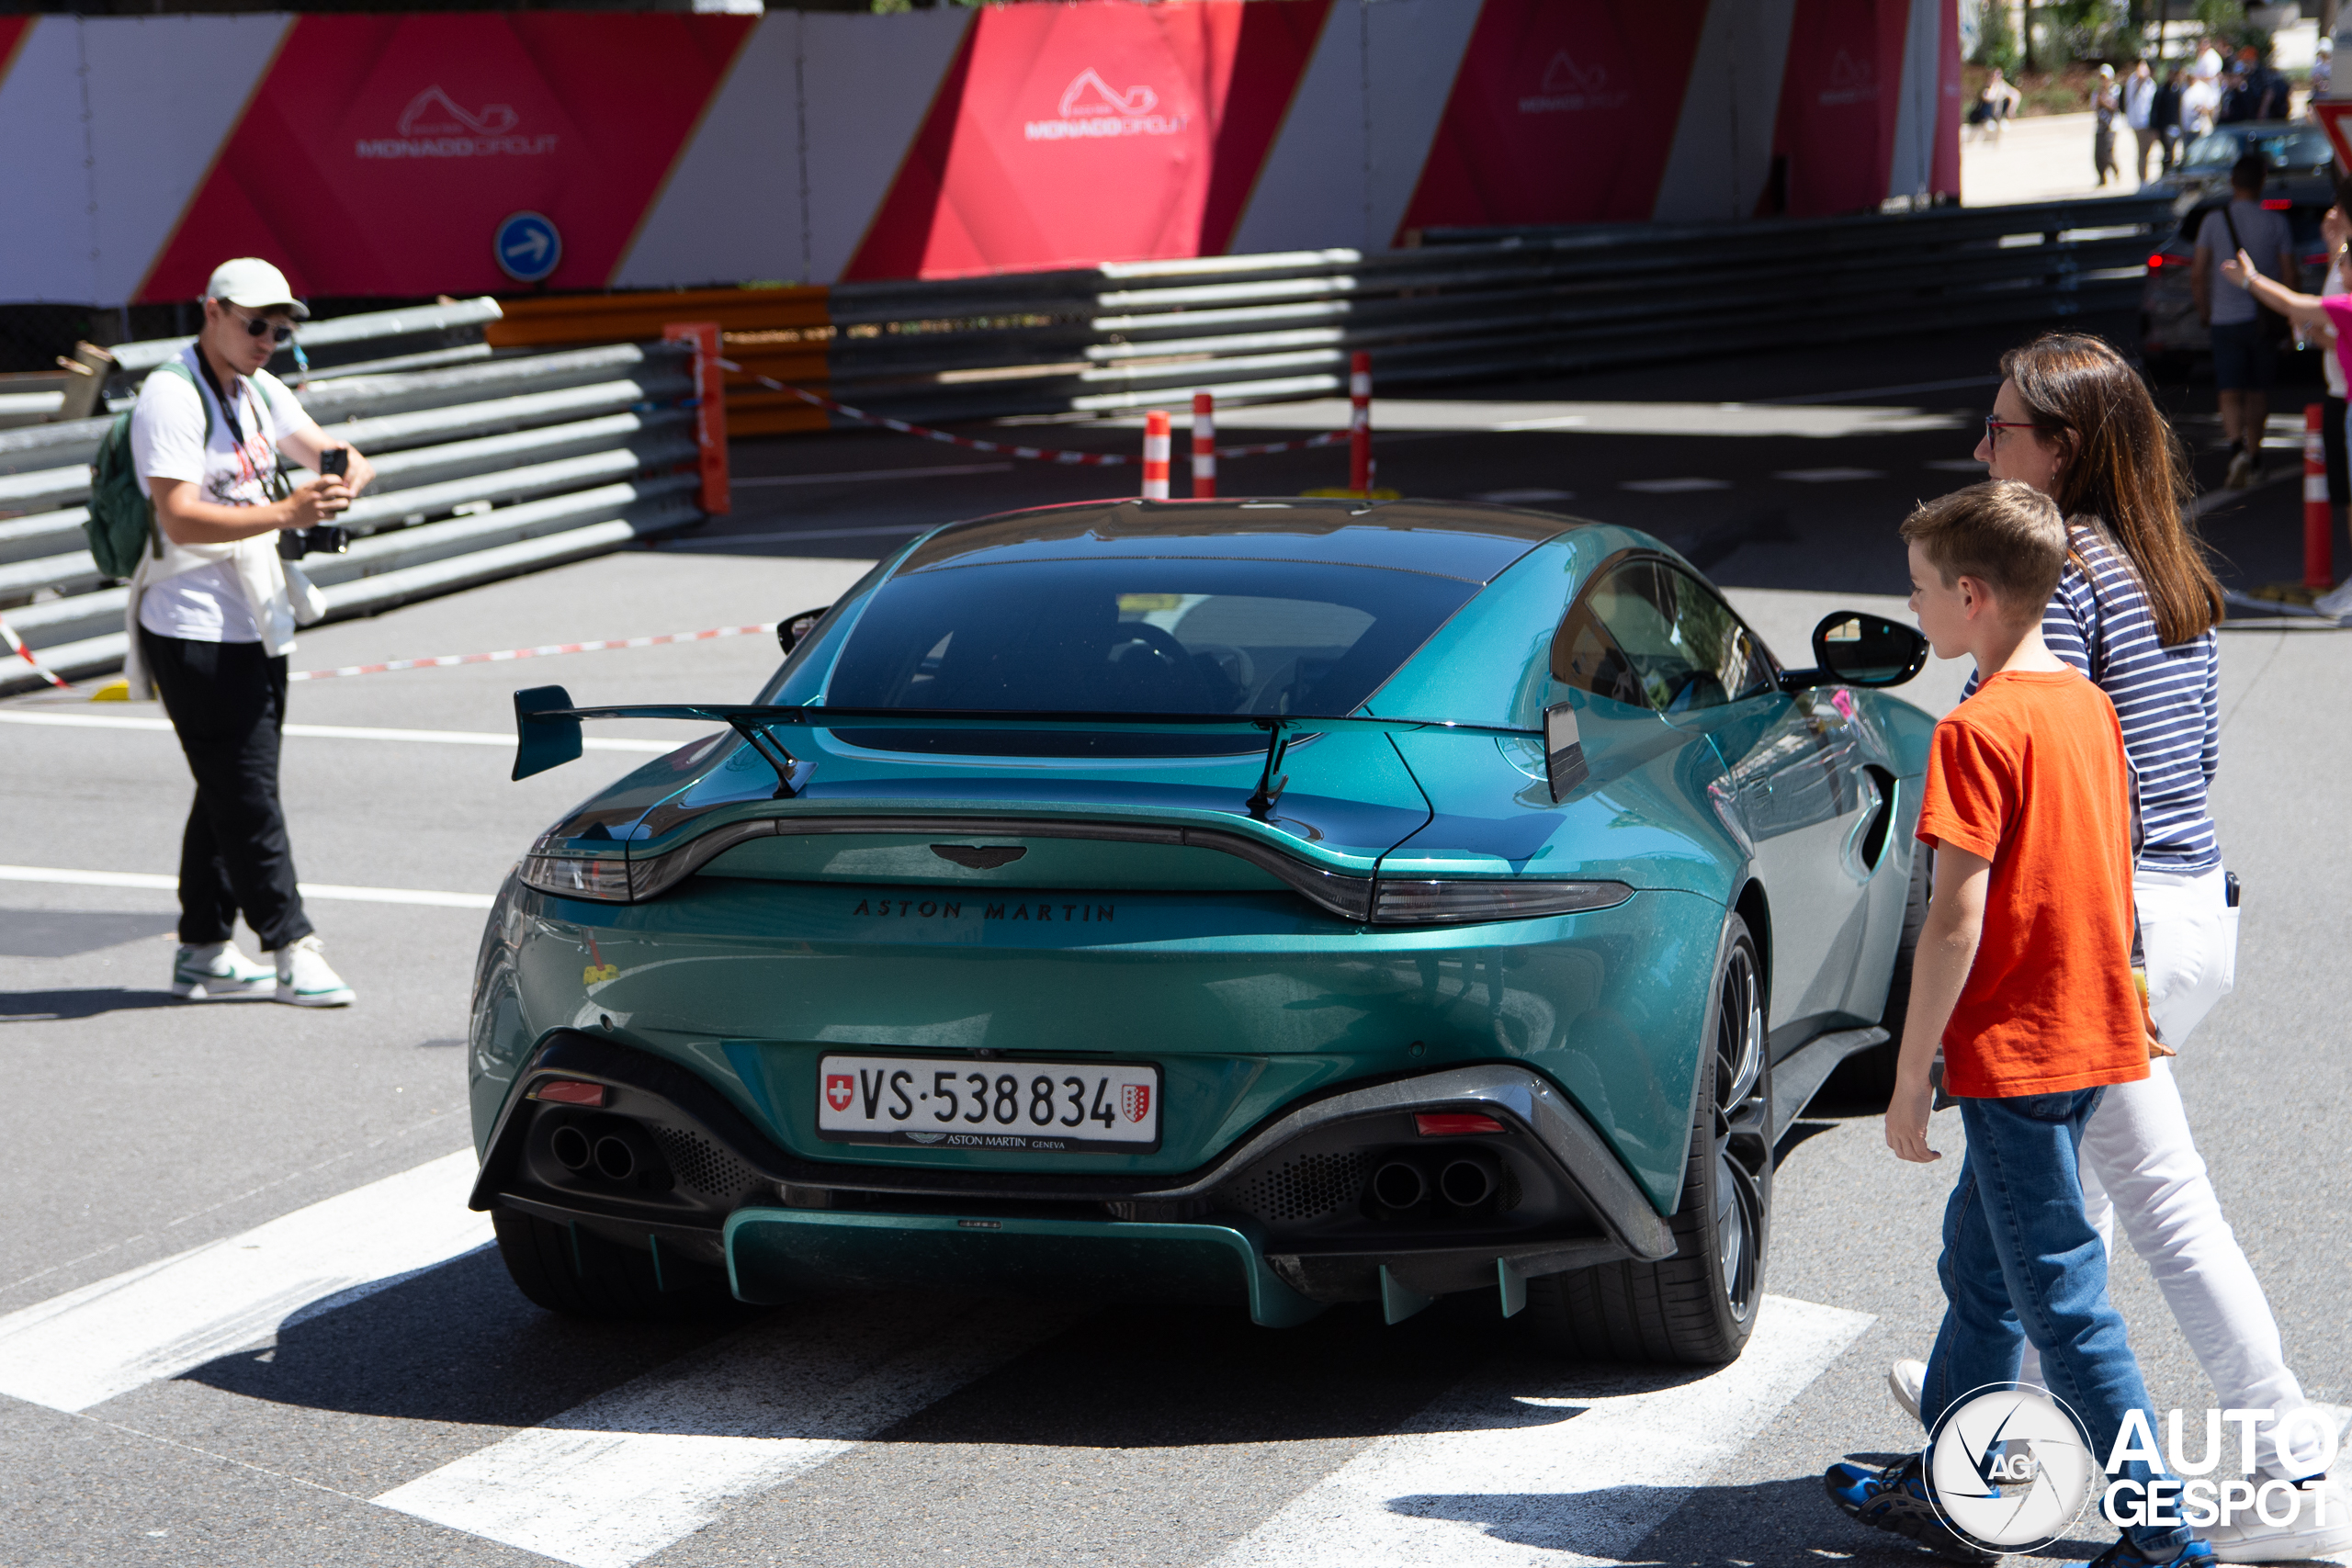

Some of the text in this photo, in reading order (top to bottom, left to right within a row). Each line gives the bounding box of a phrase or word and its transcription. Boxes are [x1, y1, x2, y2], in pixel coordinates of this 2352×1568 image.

[853, 898, 1114, 922] ASTON MARTIN
[947, 1134, 1065, 1149] ASTON MARTIN GENEVA
